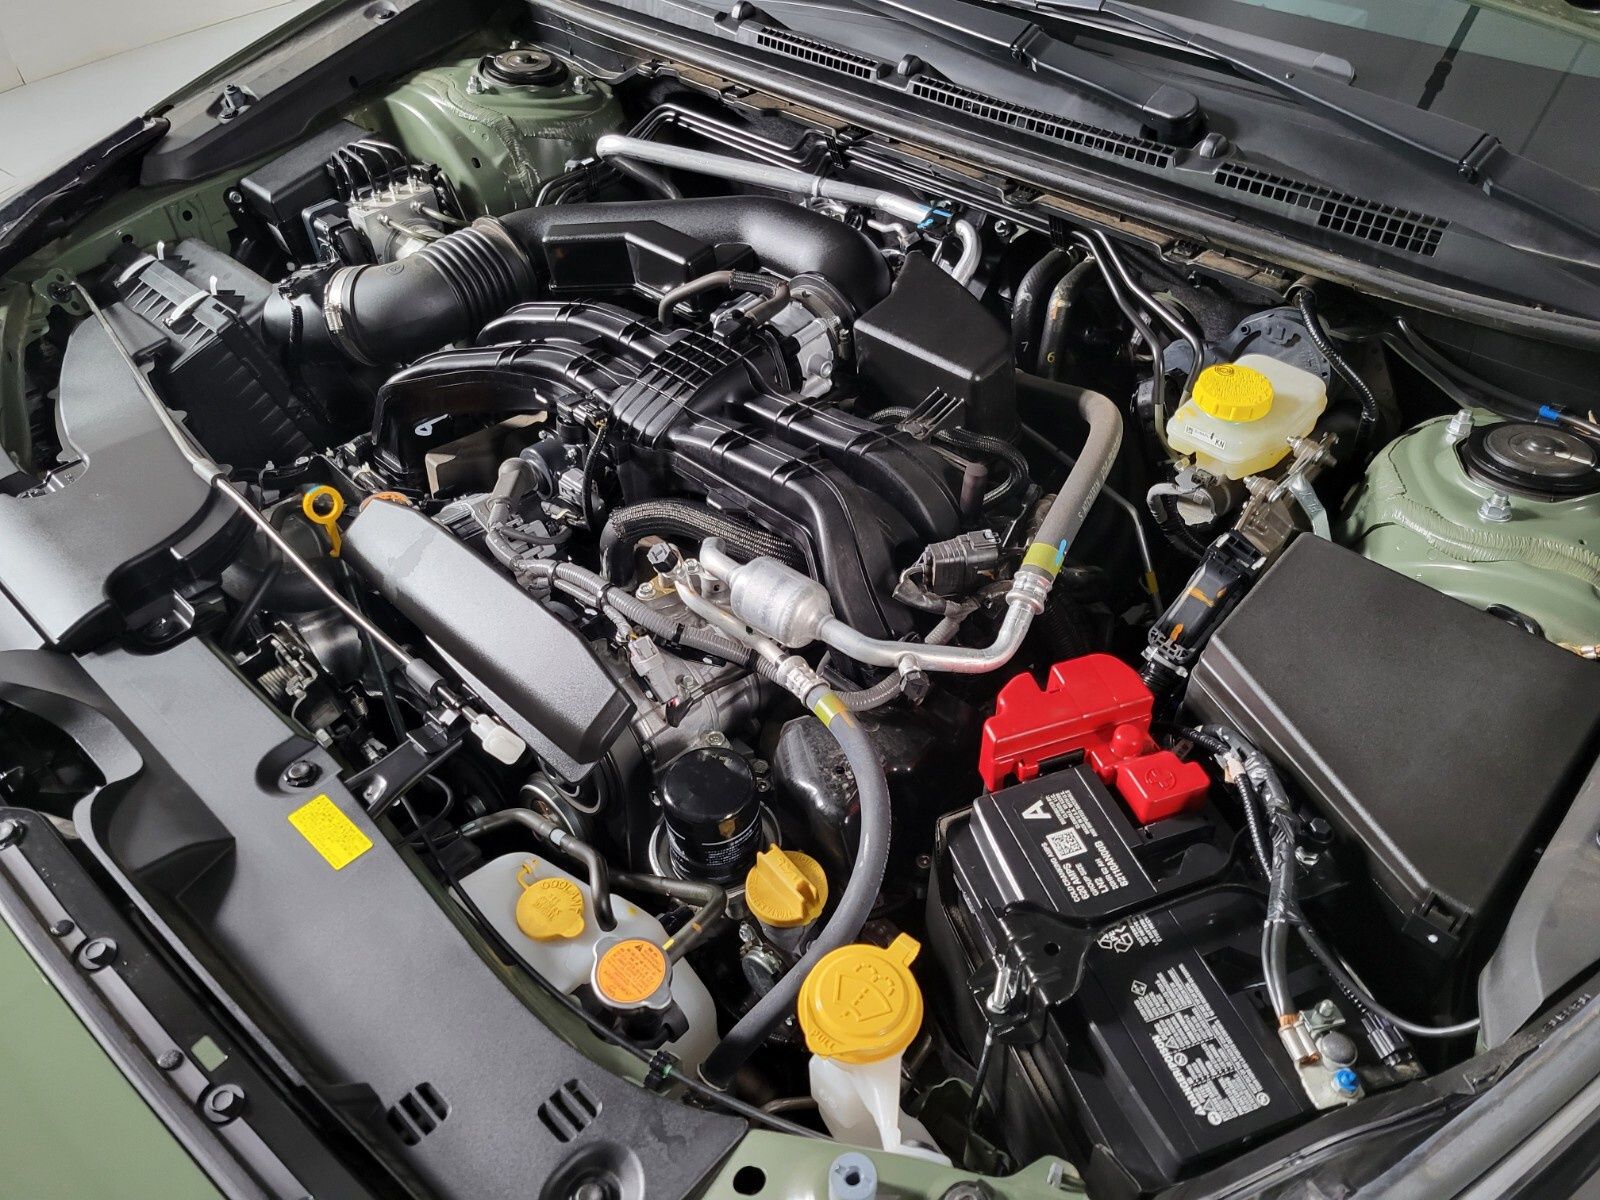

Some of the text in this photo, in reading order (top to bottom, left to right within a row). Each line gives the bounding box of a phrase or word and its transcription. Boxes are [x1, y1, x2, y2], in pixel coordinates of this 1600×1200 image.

[1021, 341, 1029, 352] 7
[1047, 351, 1055, 363] 6
[1022, 800, 1052, 819] A
[1042, 842, 1080, 902] COLD CRANKING AMPS
[1063, 863, 1089, 899] 620 AMPS
[1083, 875, 1099, 896] GROUP
[1095, 877, 1109, 893] LN2
[811, 1030, 835, 1051] PULL
[1152, 1035, 1200, 1107] DANGER/POISON
